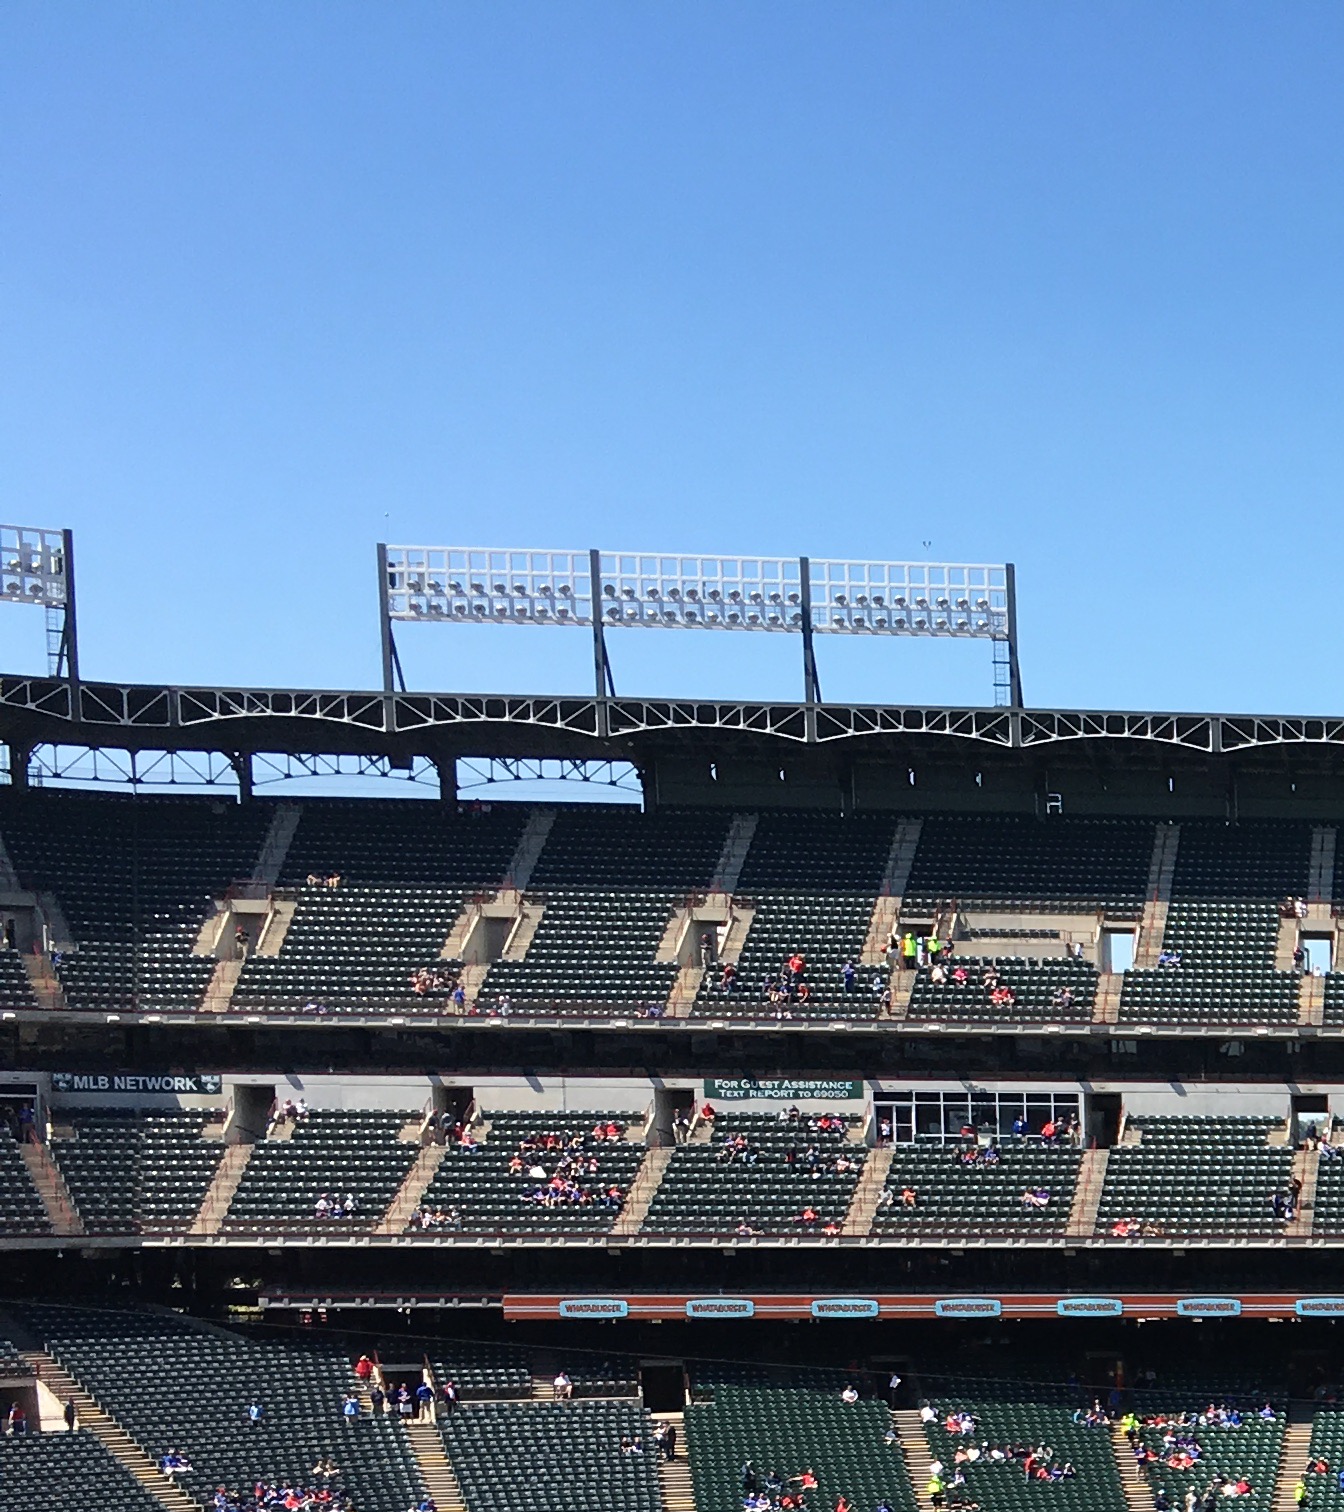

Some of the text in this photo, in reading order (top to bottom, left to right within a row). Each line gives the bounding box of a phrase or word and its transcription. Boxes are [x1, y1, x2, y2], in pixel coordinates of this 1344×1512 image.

[74, 1076, 198, 1091] MLB NETWORK
[749, 1089, 795, 1098] REPORT
[565, 1304, 623, 1314] WHATABURGER
[692, 1304, 748, 1314] WHATABURGER
[818, 1304, 873, 1313] WHATABURGER
[942, 1303, 996, 1313] WHATABURGER
[1063, 1303, 1116, 1313] WHATABURGER
[1183, 1303, 1236, 1313] WHATABURGER
